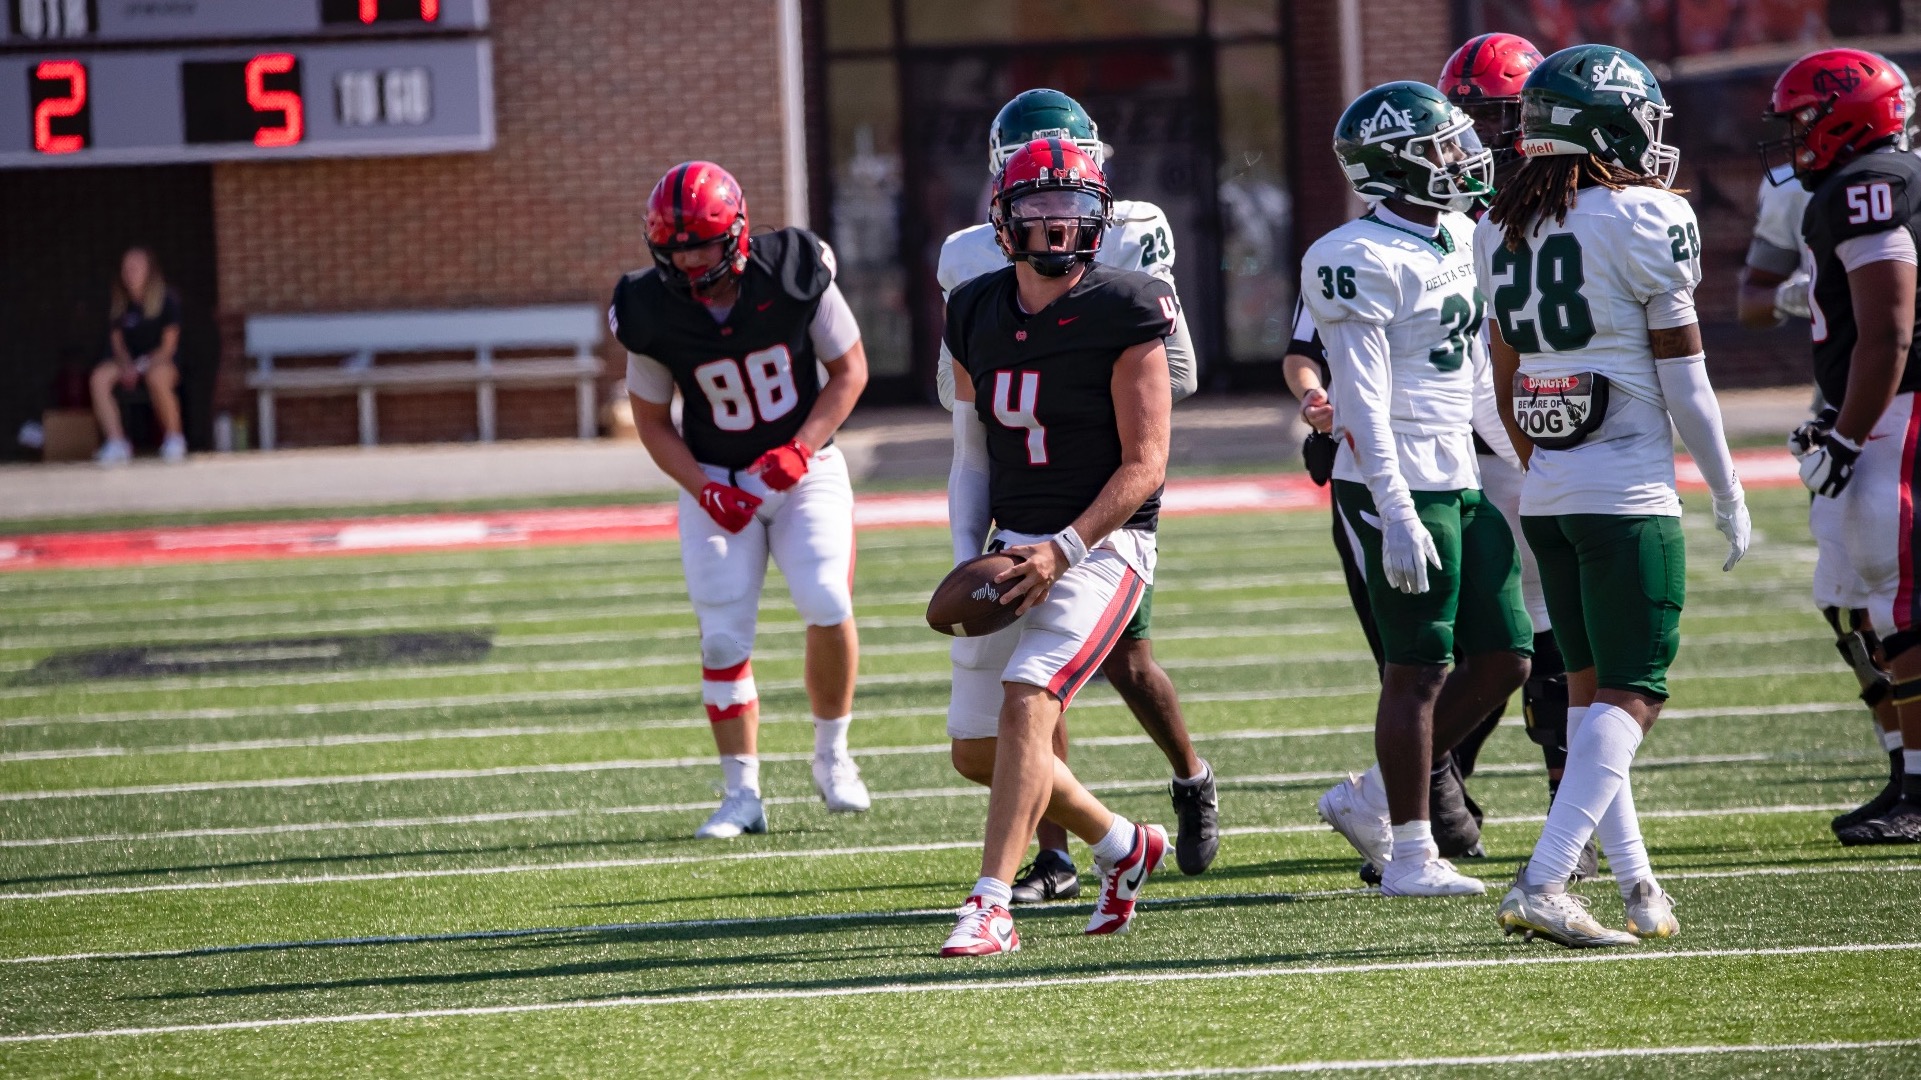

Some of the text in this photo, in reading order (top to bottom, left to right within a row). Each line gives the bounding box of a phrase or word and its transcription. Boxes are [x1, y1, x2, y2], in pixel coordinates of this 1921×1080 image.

[34, 60, 87, 154] 2
[245, 53, 303, 147] 5
[1360, 109, 1416, 138] STATE
[1847, 183, 1893, 224] 50
[1139, 226, 1170, 268] 23
[1667, 222, 1700, 263] 28
[1317, 265, 1357, 299] 36
[1425, 269, 1458, 292] DELTA
[1492, 232, 1597, 353] 28
[1157, 295, 1178, 336] 4
[694, 343, 799, 432] 88
[1529, 377, 1570, 389] DANGER
[991, 370, 1049, 465] 4
[1517, 410, 1564, 434] DOG
[1518, 399, 1563, 409] BEWARE OF
